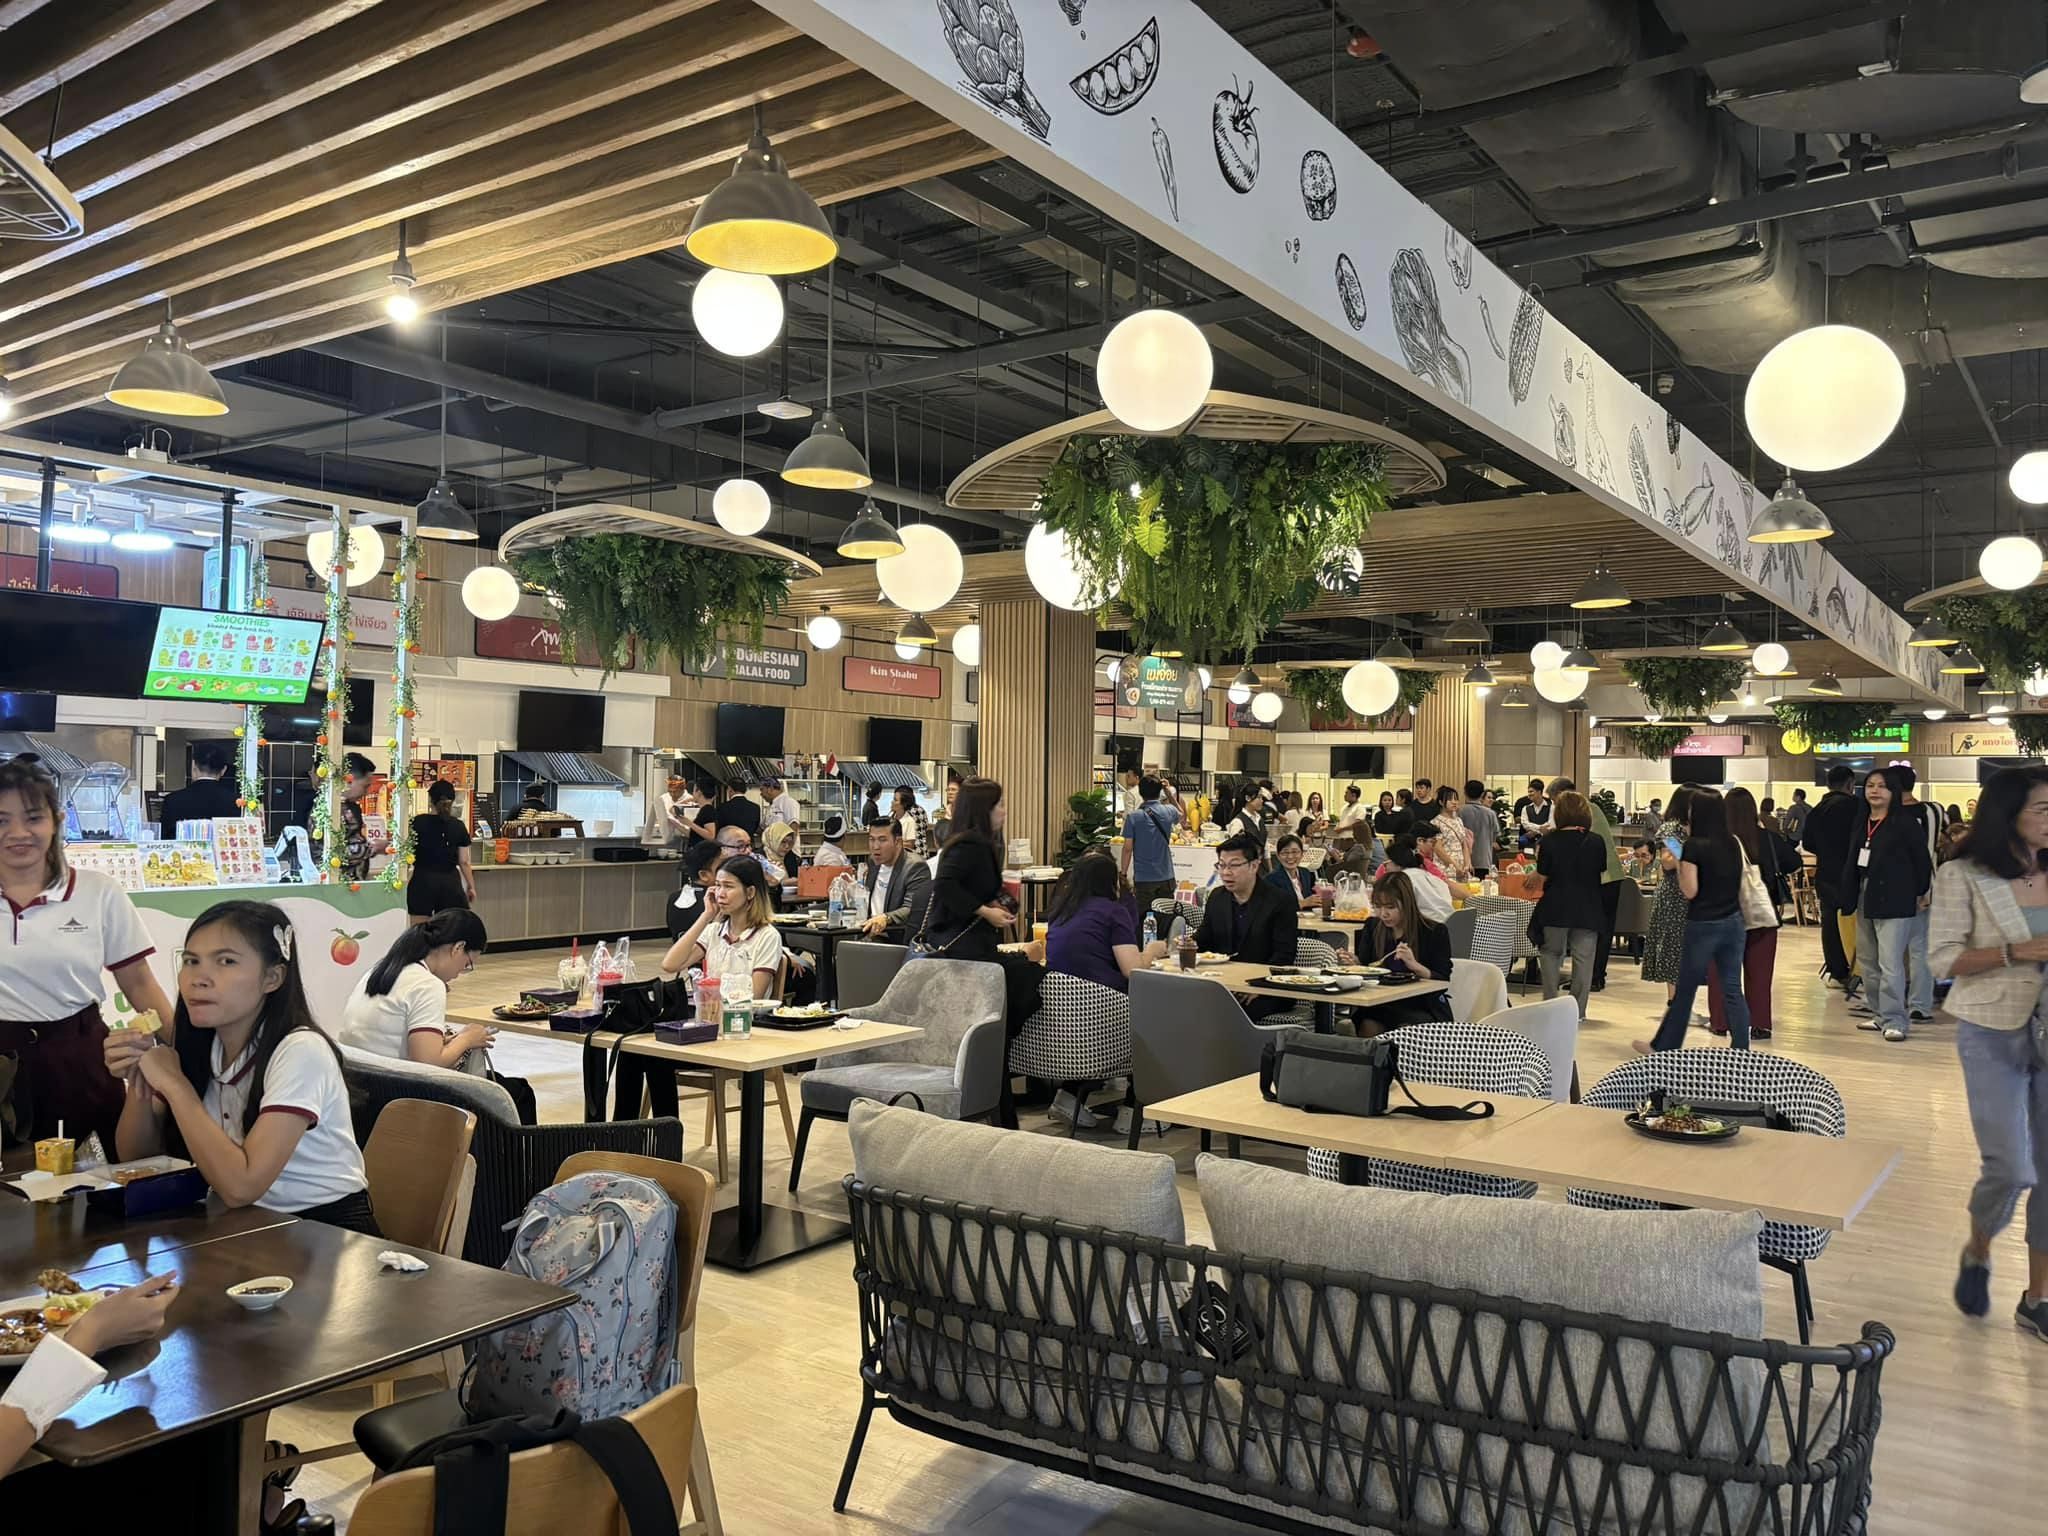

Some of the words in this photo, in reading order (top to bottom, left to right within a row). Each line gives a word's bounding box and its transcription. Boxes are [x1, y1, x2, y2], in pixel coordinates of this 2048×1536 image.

[213, 614, 271, 627] SMOOTHIES
[355, 615, 388, 630] ไข่เจียว
[765, 668, 791, 680] FOOD
[870, 665, 888, 677] Kin
[889, 668, 918, 680] Shabu
